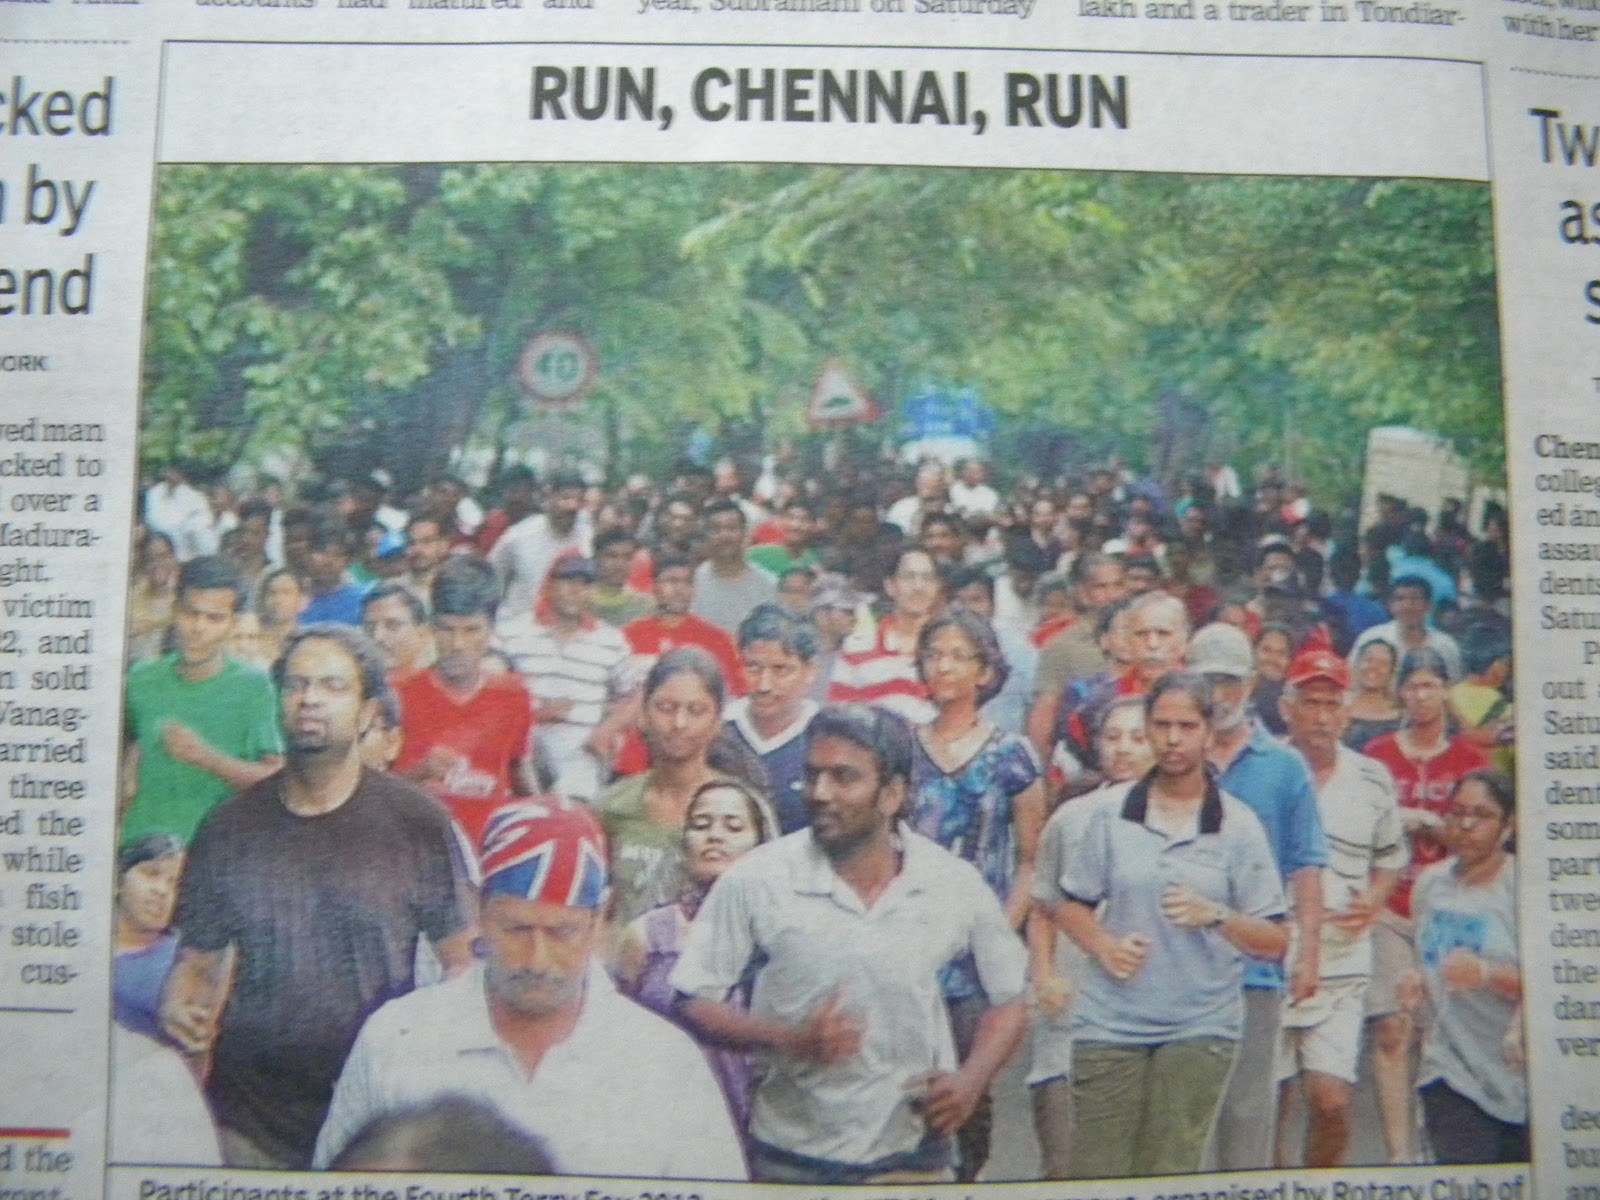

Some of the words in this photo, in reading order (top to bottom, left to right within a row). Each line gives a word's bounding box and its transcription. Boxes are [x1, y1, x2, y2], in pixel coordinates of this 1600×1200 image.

[1144, 0, 1195, 19] and
[1203, 4, 1218, 20] a
[1228, 0, 1309, 21] trader
[1319, 2, 1347, 21] in
[530, 65, 675, 130] RUN,
[690, 66, 987, 135] CHENNAI,
[1001, 72, 1129, 129] RUN
[24, 163, 97, 237] by
[0, 417, 38, 441] ed
[42, 423, 104, 441] man
[0, 452, 64, 476] cked
[76, 454, 103, 476] to
[10, 494, 75, 512] over
[84, 494, 101, 512] a
[1537, 502, 1565, 526] ed
[1540, 571, 1600, 595] dent
[3, 592, 95, 618] victim
[38, 629, 92, 654] and
[31, 664, 92, 691] sold
[10, 772, 86, 799] three
[37, 810, 85, 836] the
[3, 846, 83, 873] while
[1548, 857, 1600, 881] par
[26, 882, 81, 911] fish
[11, 919, 81, 948] stole
[20, 962, 78, 986] cus-
[1560, 1103, 1600, 1130] de
